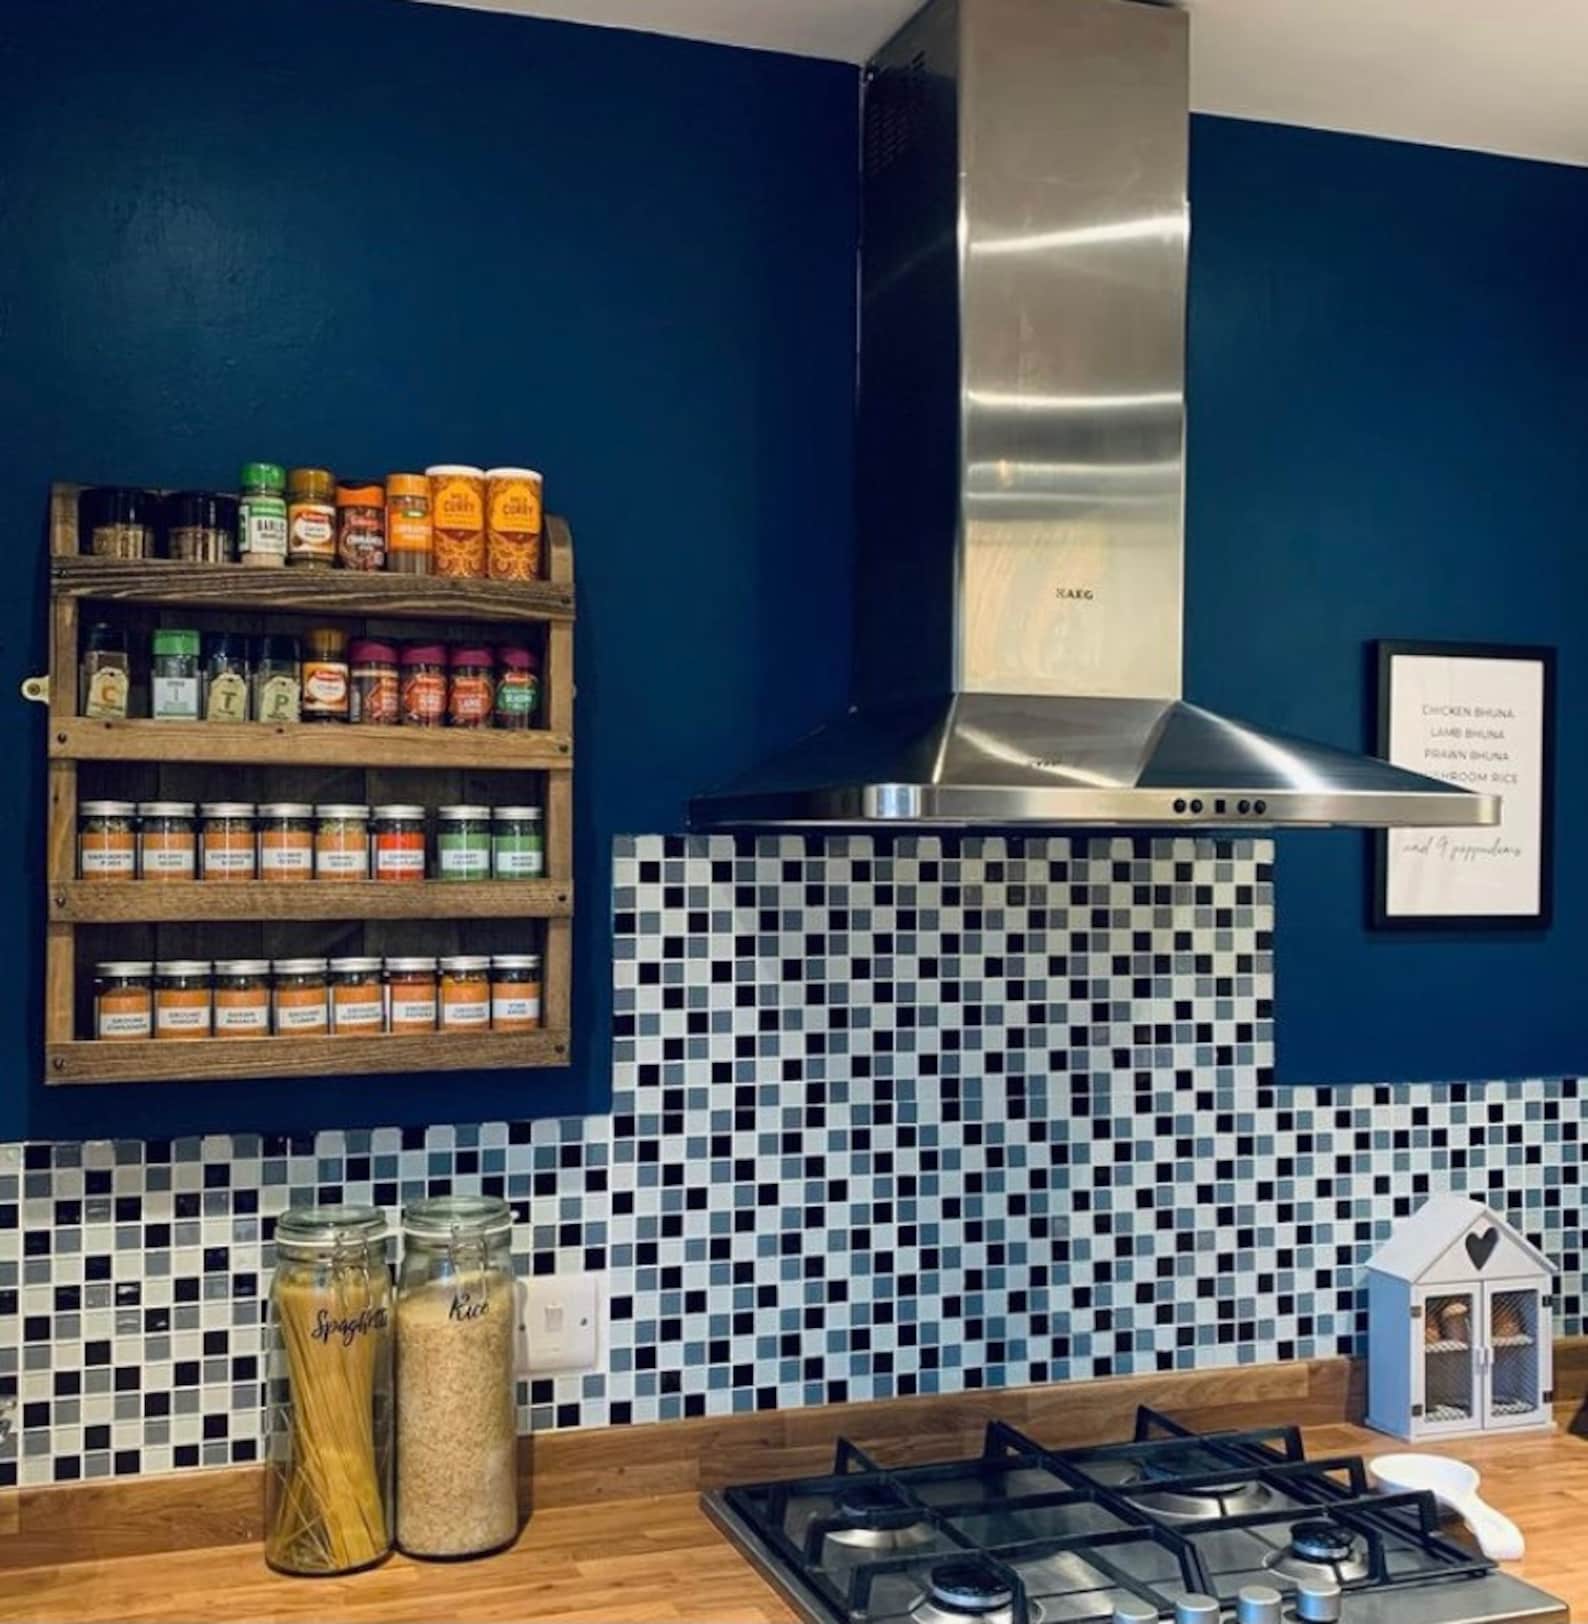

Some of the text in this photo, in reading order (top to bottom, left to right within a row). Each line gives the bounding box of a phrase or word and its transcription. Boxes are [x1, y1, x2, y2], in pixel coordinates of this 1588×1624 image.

[444, 500, 475, 513] CURRY
[503, 503, 534, 515] CURRY
[1422, 704, 1515, 718] CHICKEN BHUNA
[1431, 728, 1505, 739] LAMB BHUNA
[1424, 748, 1510, 761] PRAWN BHUNA
[1491, 772, 1518, 784] RICE
[1403, 836, 1434, 856] and
[1436, 835, 1449, 860] 9
[449, 1294, 491, 1322] Rice
[311, 1308, 389, 1347] Spaghetti
